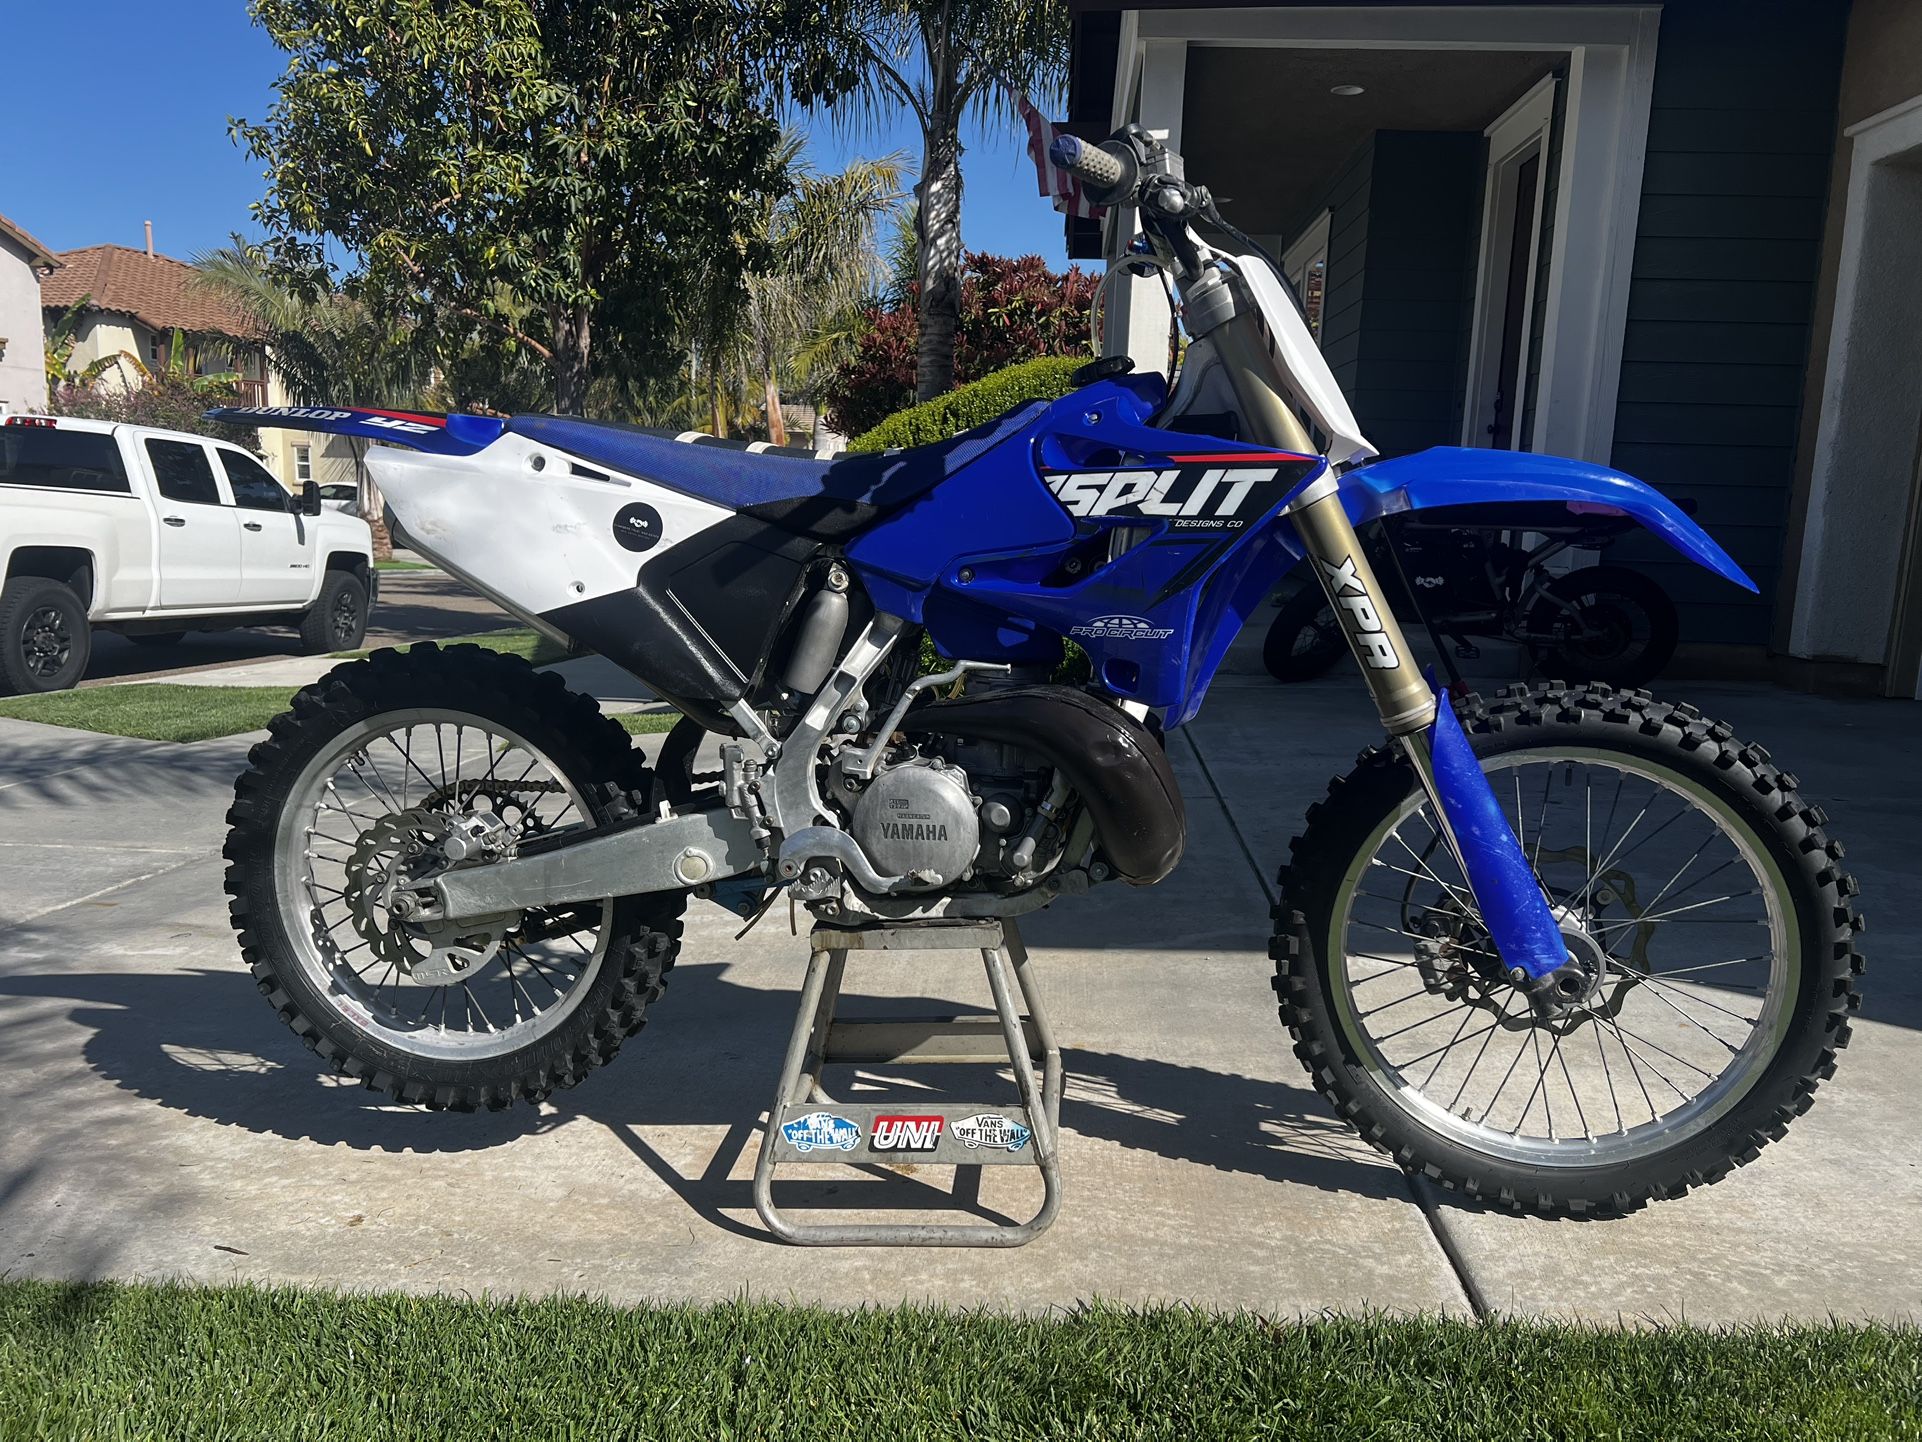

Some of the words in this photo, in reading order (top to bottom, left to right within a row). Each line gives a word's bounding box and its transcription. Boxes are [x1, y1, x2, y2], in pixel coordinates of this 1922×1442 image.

[233, 406, 351, 421] DUNLOP
[1174, 519, 1225, 528] DESIGNS
[1226, 520, 1244, 528] CO
[1319, 553, 1400, 669] XPR
[1069, 625, 1107, 639] PRO
[1105, 627, 1175, 640] CIRCUIT
[880, 822, 948, 841] YAMAHA
[976, 1116, 1004, 1129] VANS
[978, 1129, 998, 1143] THE
